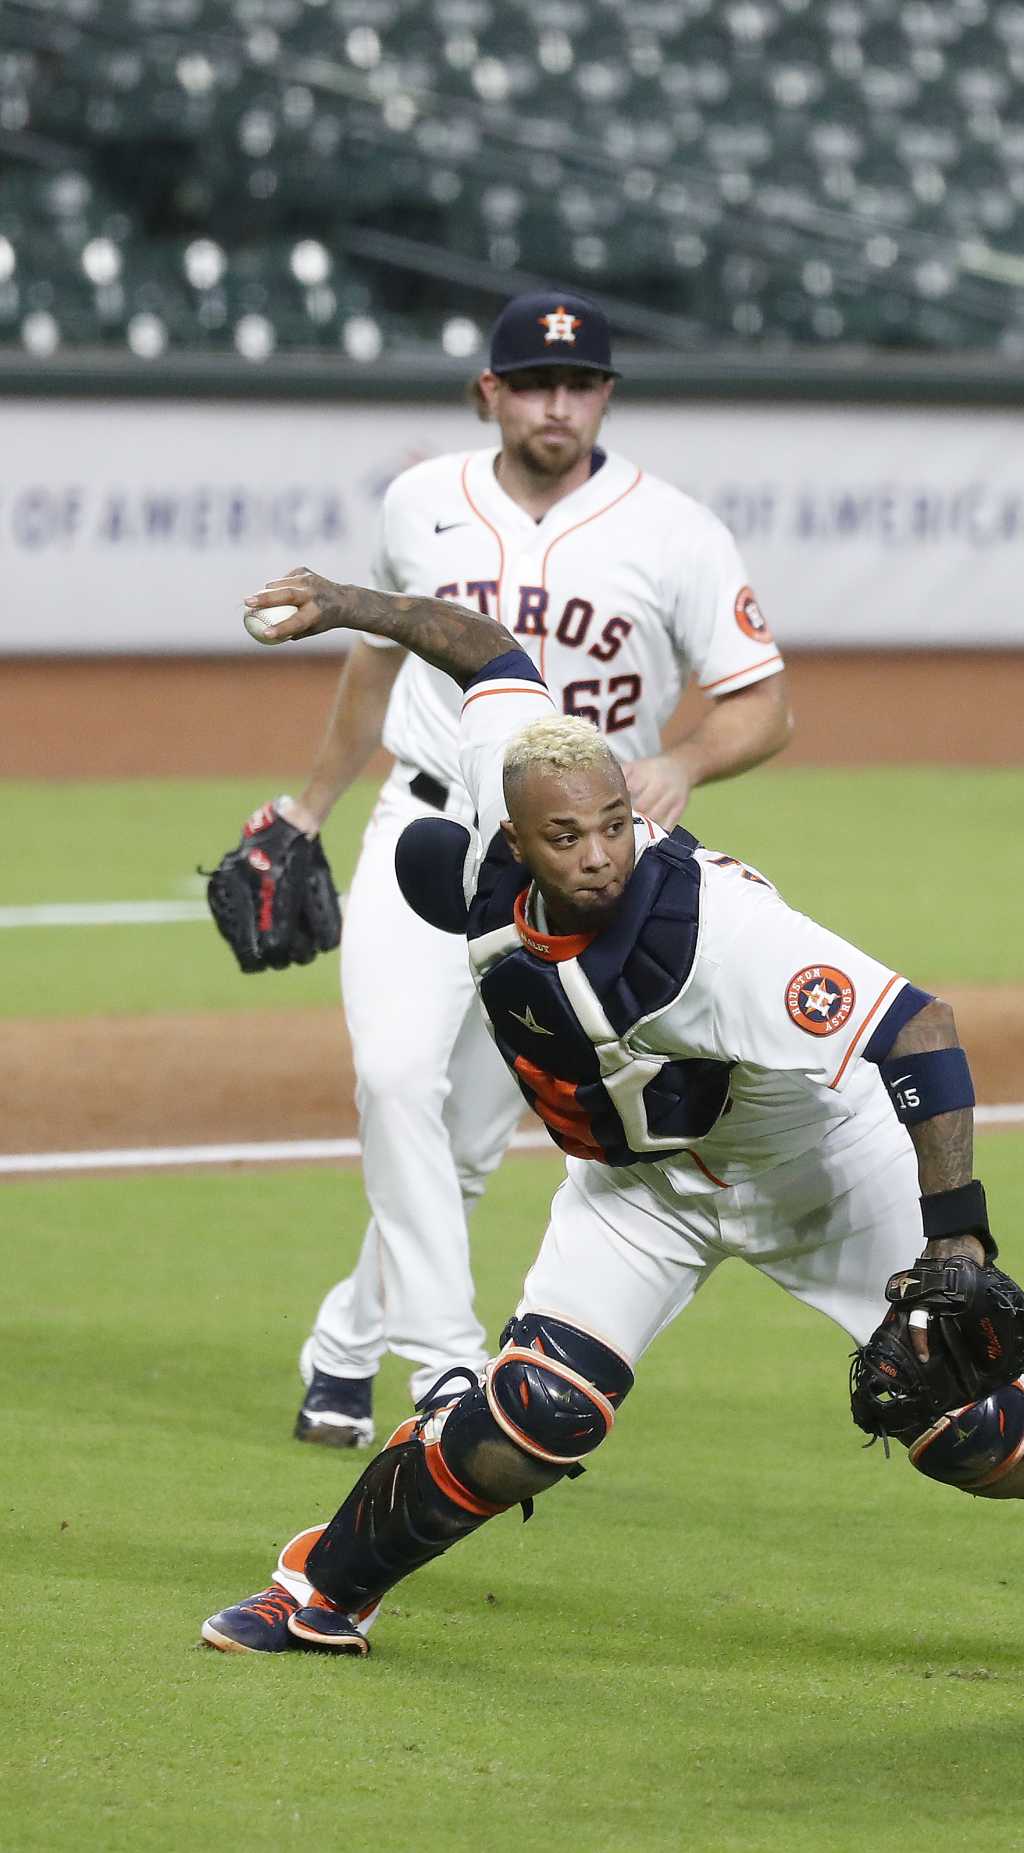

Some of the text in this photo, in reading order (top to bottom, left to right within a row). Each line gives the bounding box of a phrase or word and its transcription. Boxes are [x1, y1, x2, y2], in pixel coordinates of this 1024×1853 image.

[434, 580, 634, 662] TROS
[562, 673, 643, 734] 62
[788, 967, 821, 1017] HOUSTON
[825, 988, 852, 1031] ASTROS
[896, 1088, 920, 1110] 15
